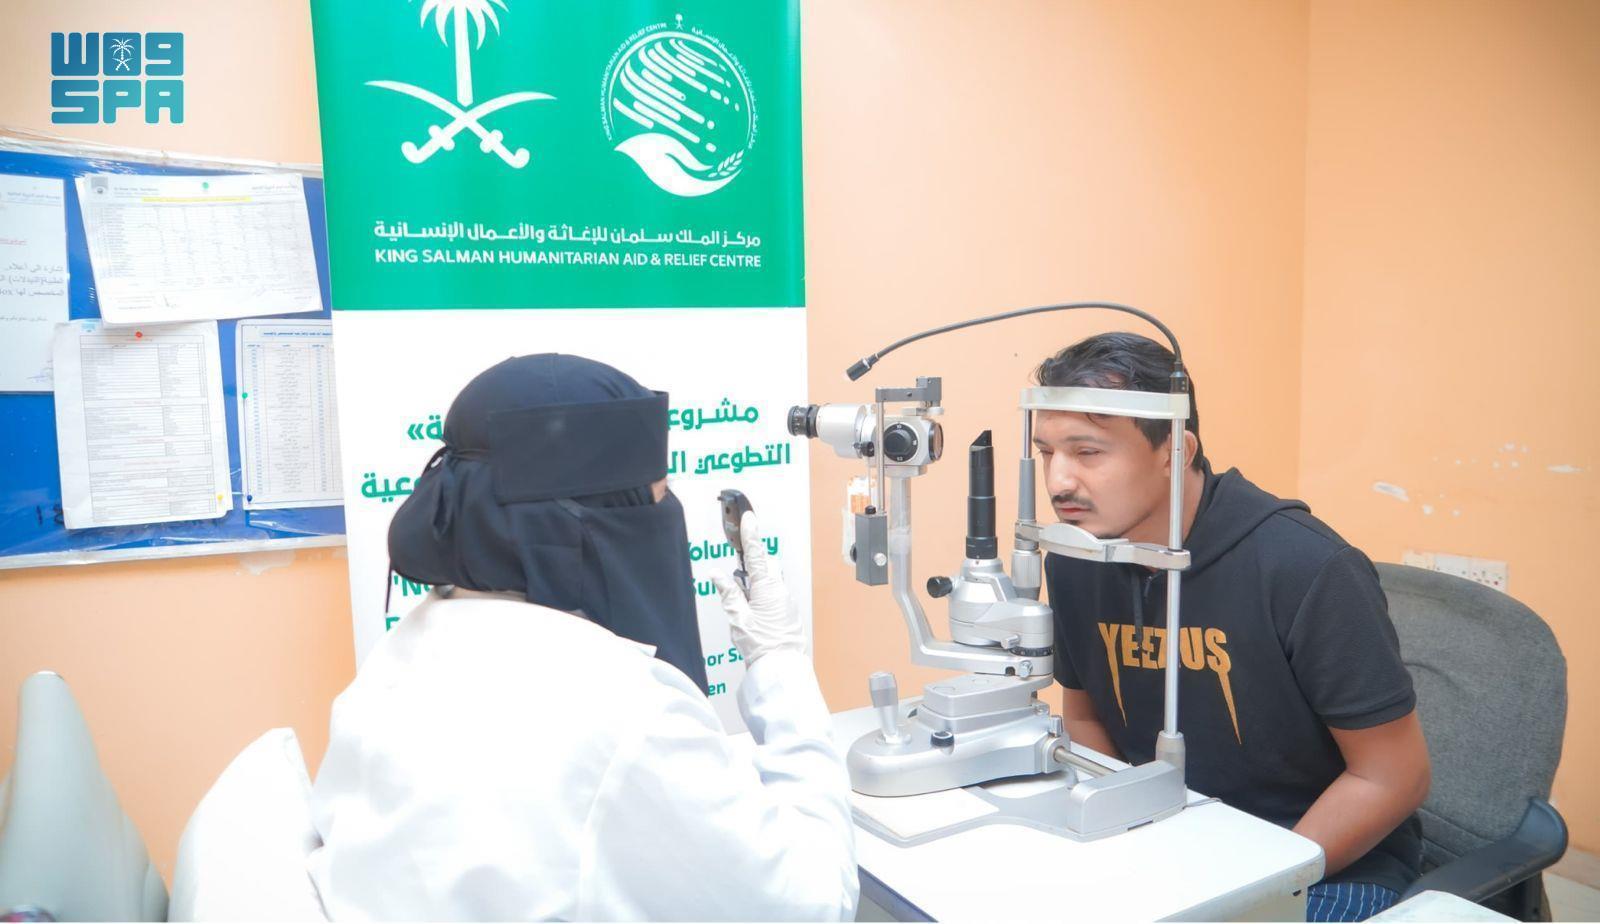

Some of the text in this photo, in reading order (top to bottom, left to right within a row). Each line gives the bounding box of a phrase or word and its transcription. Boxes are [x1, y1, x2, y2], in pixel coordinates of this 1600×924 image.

[374, 220, 761, 248] مركز الملك سلمان للإغاثة والأعمال الإنسانية
[375, 249, 761, 267] KING SALMAN HUMANITARIAN AID & RELIEF CENTRE
[694, 443, 790, 475] التطوعي
